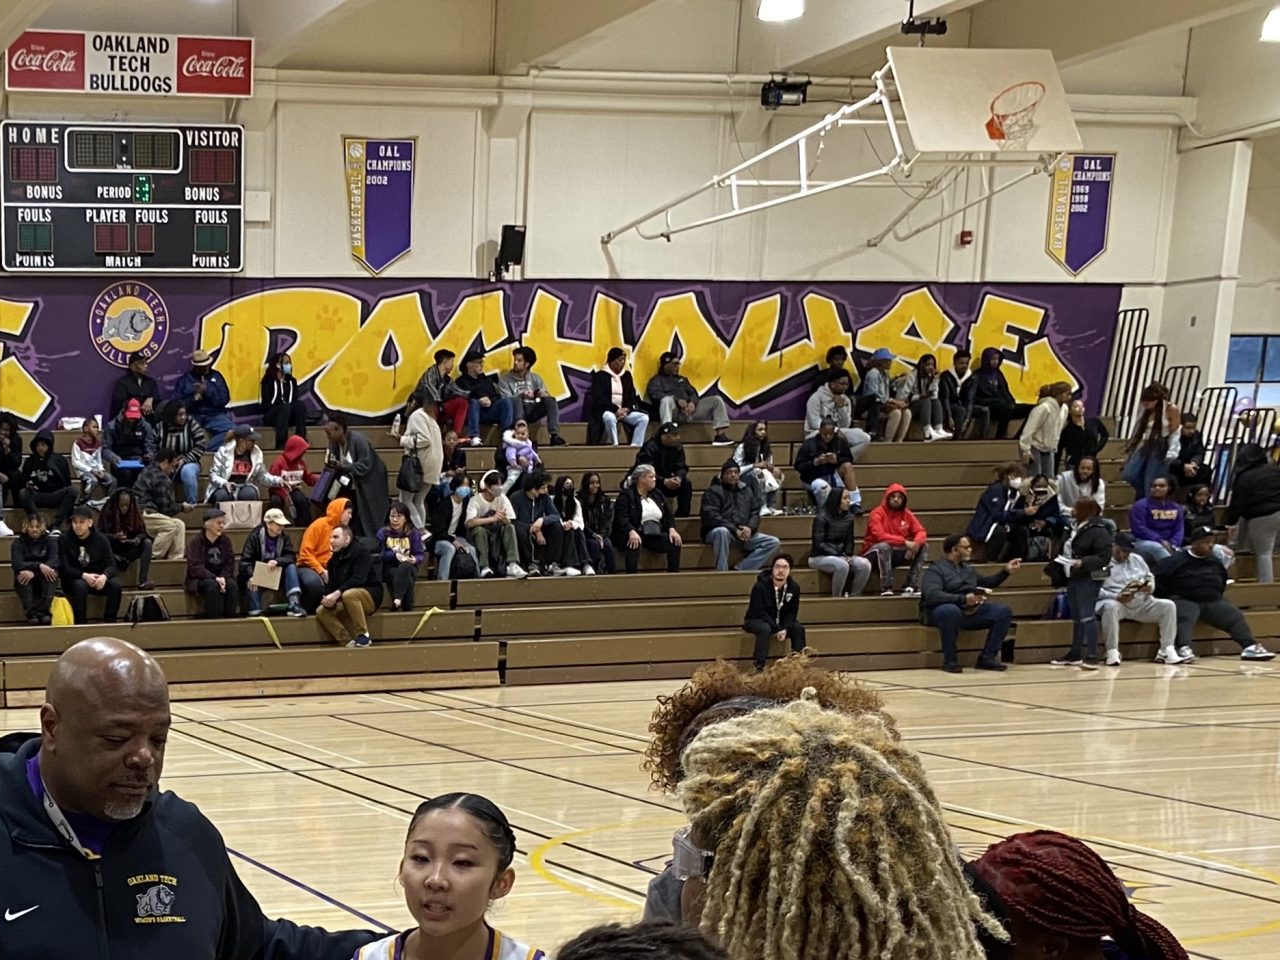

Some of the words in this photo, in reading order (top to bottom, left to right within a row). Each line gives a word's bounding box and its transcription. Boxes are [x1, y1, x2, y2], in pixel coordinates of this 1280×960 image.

[92, 34, 170, 54] OAKLAND
[11, 48, 78, 72] Coca-Cola
[107, 55, 150, 73] TECH
[182, 54, 247, 78] Coca-Cola
[89, 74, 172, 93] BULLDOGS
[8, 127, 60, 144] HOME
[186, 130, 239, 147] VISITOR
[379, 145, 400, 157] OAL
[366, 160, 412, 172] CHAMPIONS
[1083, 159, 1102, 170] OAL
[366, 175, 388, 185] 2002
[1072, 171, 1111, 182] CHAMPIONS
[26, 185, 63, 199] BONUS
[96, 186, 132, 199] PERIOD
[184, 187, 220, 201] BONUS
[17, 208, 52, 222] FOULS
[85, 209, 126, 223] PLAYER
[135, 209, 169, 224] FOULS
[195, 210, 228, 224] FOULS
[351, 174, 362, 246] BASKETBALL
[1054, 178, 1069, 249] BASEBALL
[15, 253, 55, 267] POINTS
[105, 255, 142, 268] MATCH
[192, 254, 230, 267] POINTS
[95, 285, 140, 316] OAKLAND
[145, 293, 165, 322] TECH
[96, 336, 158, 364] BULLGS
[199, 286, 1080, 416] DOGHOUSE
[127, 874, 159, 886] OAKLAND
